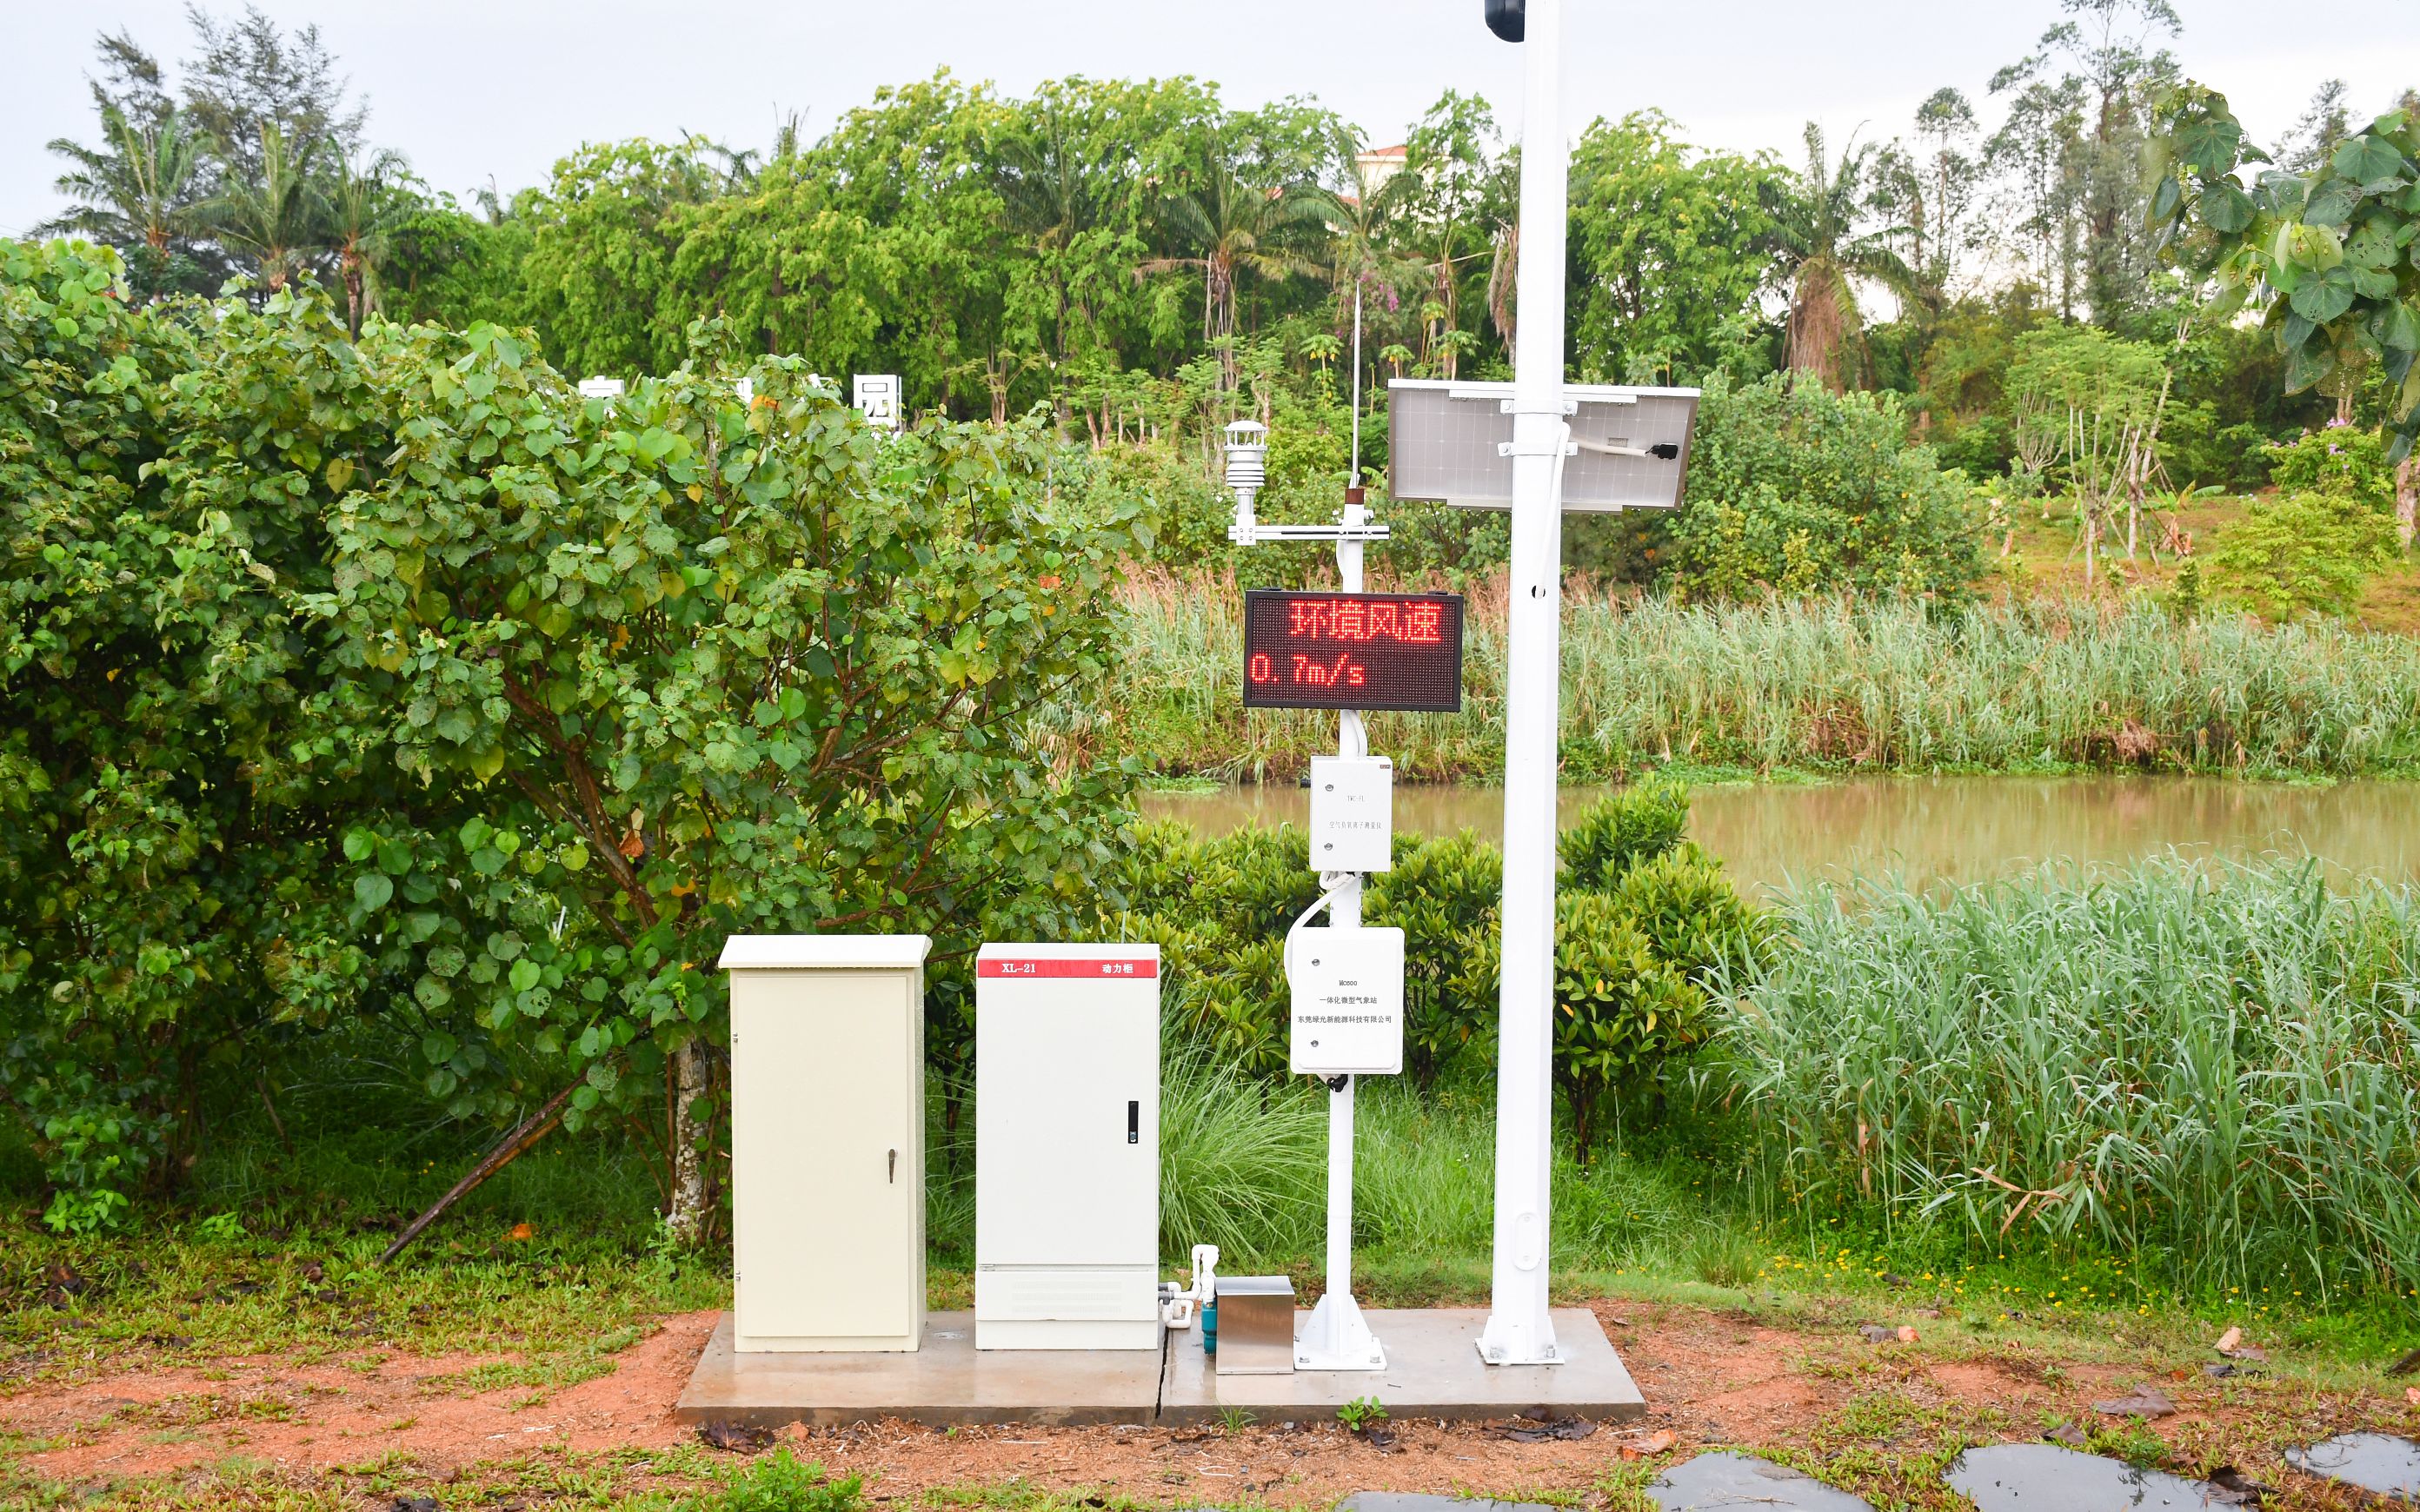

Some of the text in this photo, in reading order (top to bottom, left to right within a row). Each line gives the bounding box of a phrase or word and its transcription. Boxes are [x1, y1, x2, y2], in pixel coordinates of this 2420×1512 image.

[1289, 599, 1442, 642] 环境风速
[1001, 963, 1036, 973] XL-21
[1101, 963, 1134, 974] 动力柜
[1319, 996, 1378, 1005] 一体化微型气象站
[1297, 1015, 1393, 1024] 东莞绿光新能源科技有限公司
